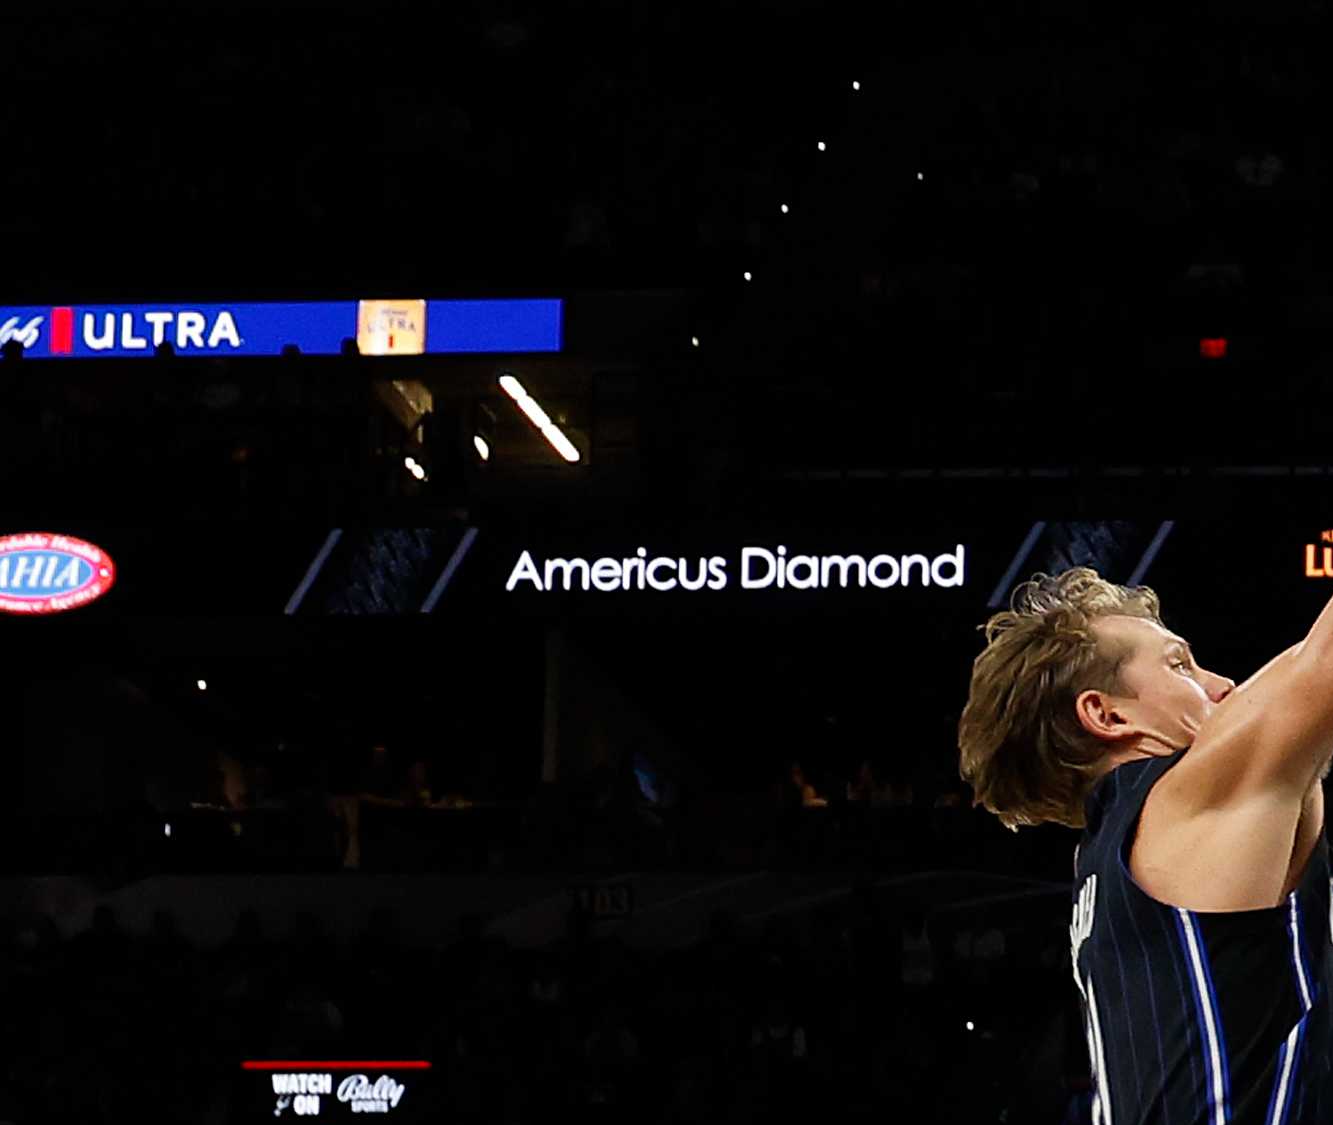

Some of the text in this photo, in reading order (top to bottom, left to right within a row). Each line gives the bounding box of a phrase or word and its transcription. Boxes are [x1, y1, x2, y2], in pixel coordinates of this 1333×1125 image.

[82, 310, 241, 350] ULTRA
[505, 545, 966, 591] Americus Diamond
[272, 1073, 332, 1094] WATCH
[293, 1095, 320, 1115] ON
